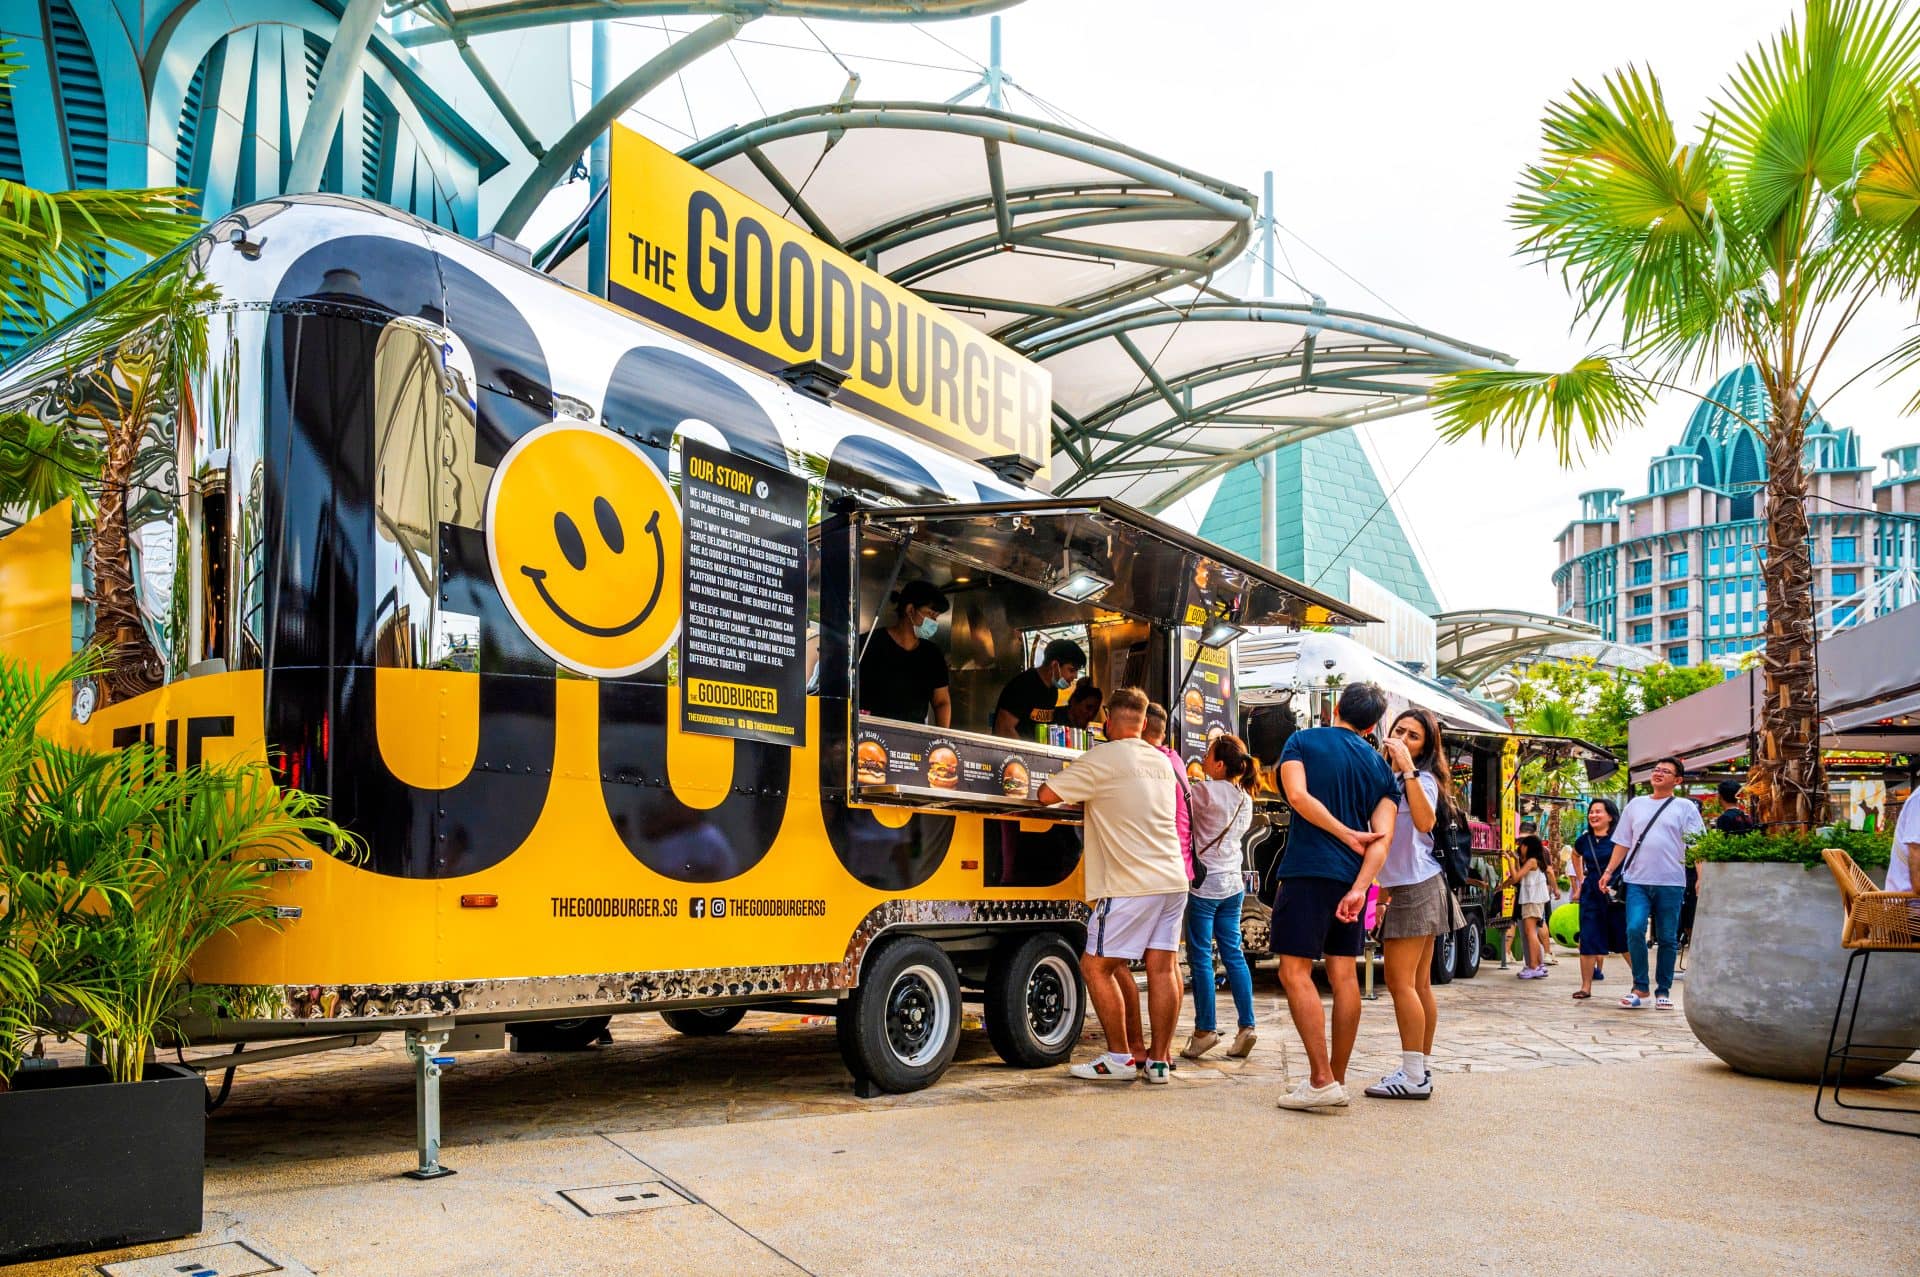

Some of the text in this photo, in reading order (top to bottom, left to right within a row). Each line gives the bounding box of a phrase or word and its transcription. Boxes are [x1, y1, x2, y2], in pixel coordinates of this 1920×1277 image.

[628, 190, 1044, 468] THE GOODBURGER
[689, 456, 754, 495] OUR STORY
[690, 487, 698, 497] WE
[699, 490, 711, 501] LOVE
[740, 502, 749, 513] BUT
[751, 506, 758, 516] WE
[759, 508, 770, 519] LOVE
[771, 512, 791, 526] ANIMALS
[792, 519, 802, 529] AND
[690, 500, 700, 511] OUR
[701, 503, 720, 517] PLANET
[721, 509, 733, 521] EVEN
[690, 518, 707, 531] THAT'S
[709, 524, 719, 534] WHY
[721, 527, 729, 537] WE
[730, 530, 750, 543] STARTED
[751, 536, 760, 546] THE
[792, 548, 798, 556] TO
[690, 532, 798, 569] SERVE DELICIOUS PLANT-BASED BURGERS THAT
[690, 544, 783, 576] ARE AS GOOD OR BETTER THAN REGULAR
[690, 557, 713, 571] BURGERS
[714, 564, 728, 575] MADE
[729, 567, 743, 578] FROM
[757, 575, 765, 584] IT'S
[766, 577, 778, 587] ALSO
[779, 580, 783, 588] A
[690, 570, 794, 603] PLATFORM TO DRIVE CHANGE FOR A GREENER
[690, 583, 700, 594] AND
[702, 586, 720, 598] KINDER
[743, 596, 752, 606] ONE
[753, 598, 771, 610] BURGER
[772, 603, 777, 612] AT
[778, 604, 782, 613] A
[690, 601, 793, 632] WE BELIEVE THAT MANY SMALL ACTIONS CAN
[690, 615, 707, 626] RESULT
[708, 619, 714, 628] IN
[715, 620, 730, 631] GREAT
[755, 629, 761, 638] SO
[762, 630, 768, 639] BY
[769, 632, 782, 642] DOING
[784, 635, 795, 645] GOOD
[689, 641, 716, 654] WHENEVER
[718, 646, 725, 656] WE
[739, 650, 752, 661] WE'LL
[754, 653, 766, 664] MAKE
[768, 656, 771, 664] A
[772, 657, 783, 667] REAL
[690, 628, 795, 657] THINGS LIKE RECYCLING AND GOING MEATLESS
[689, 654, 719, 668] DIFFERENCE
[698, 683, 774, 711] GOODBURGER
[551, 897, 826, 918] THEGOODBURGER.SG THEGOODBURGERSG
